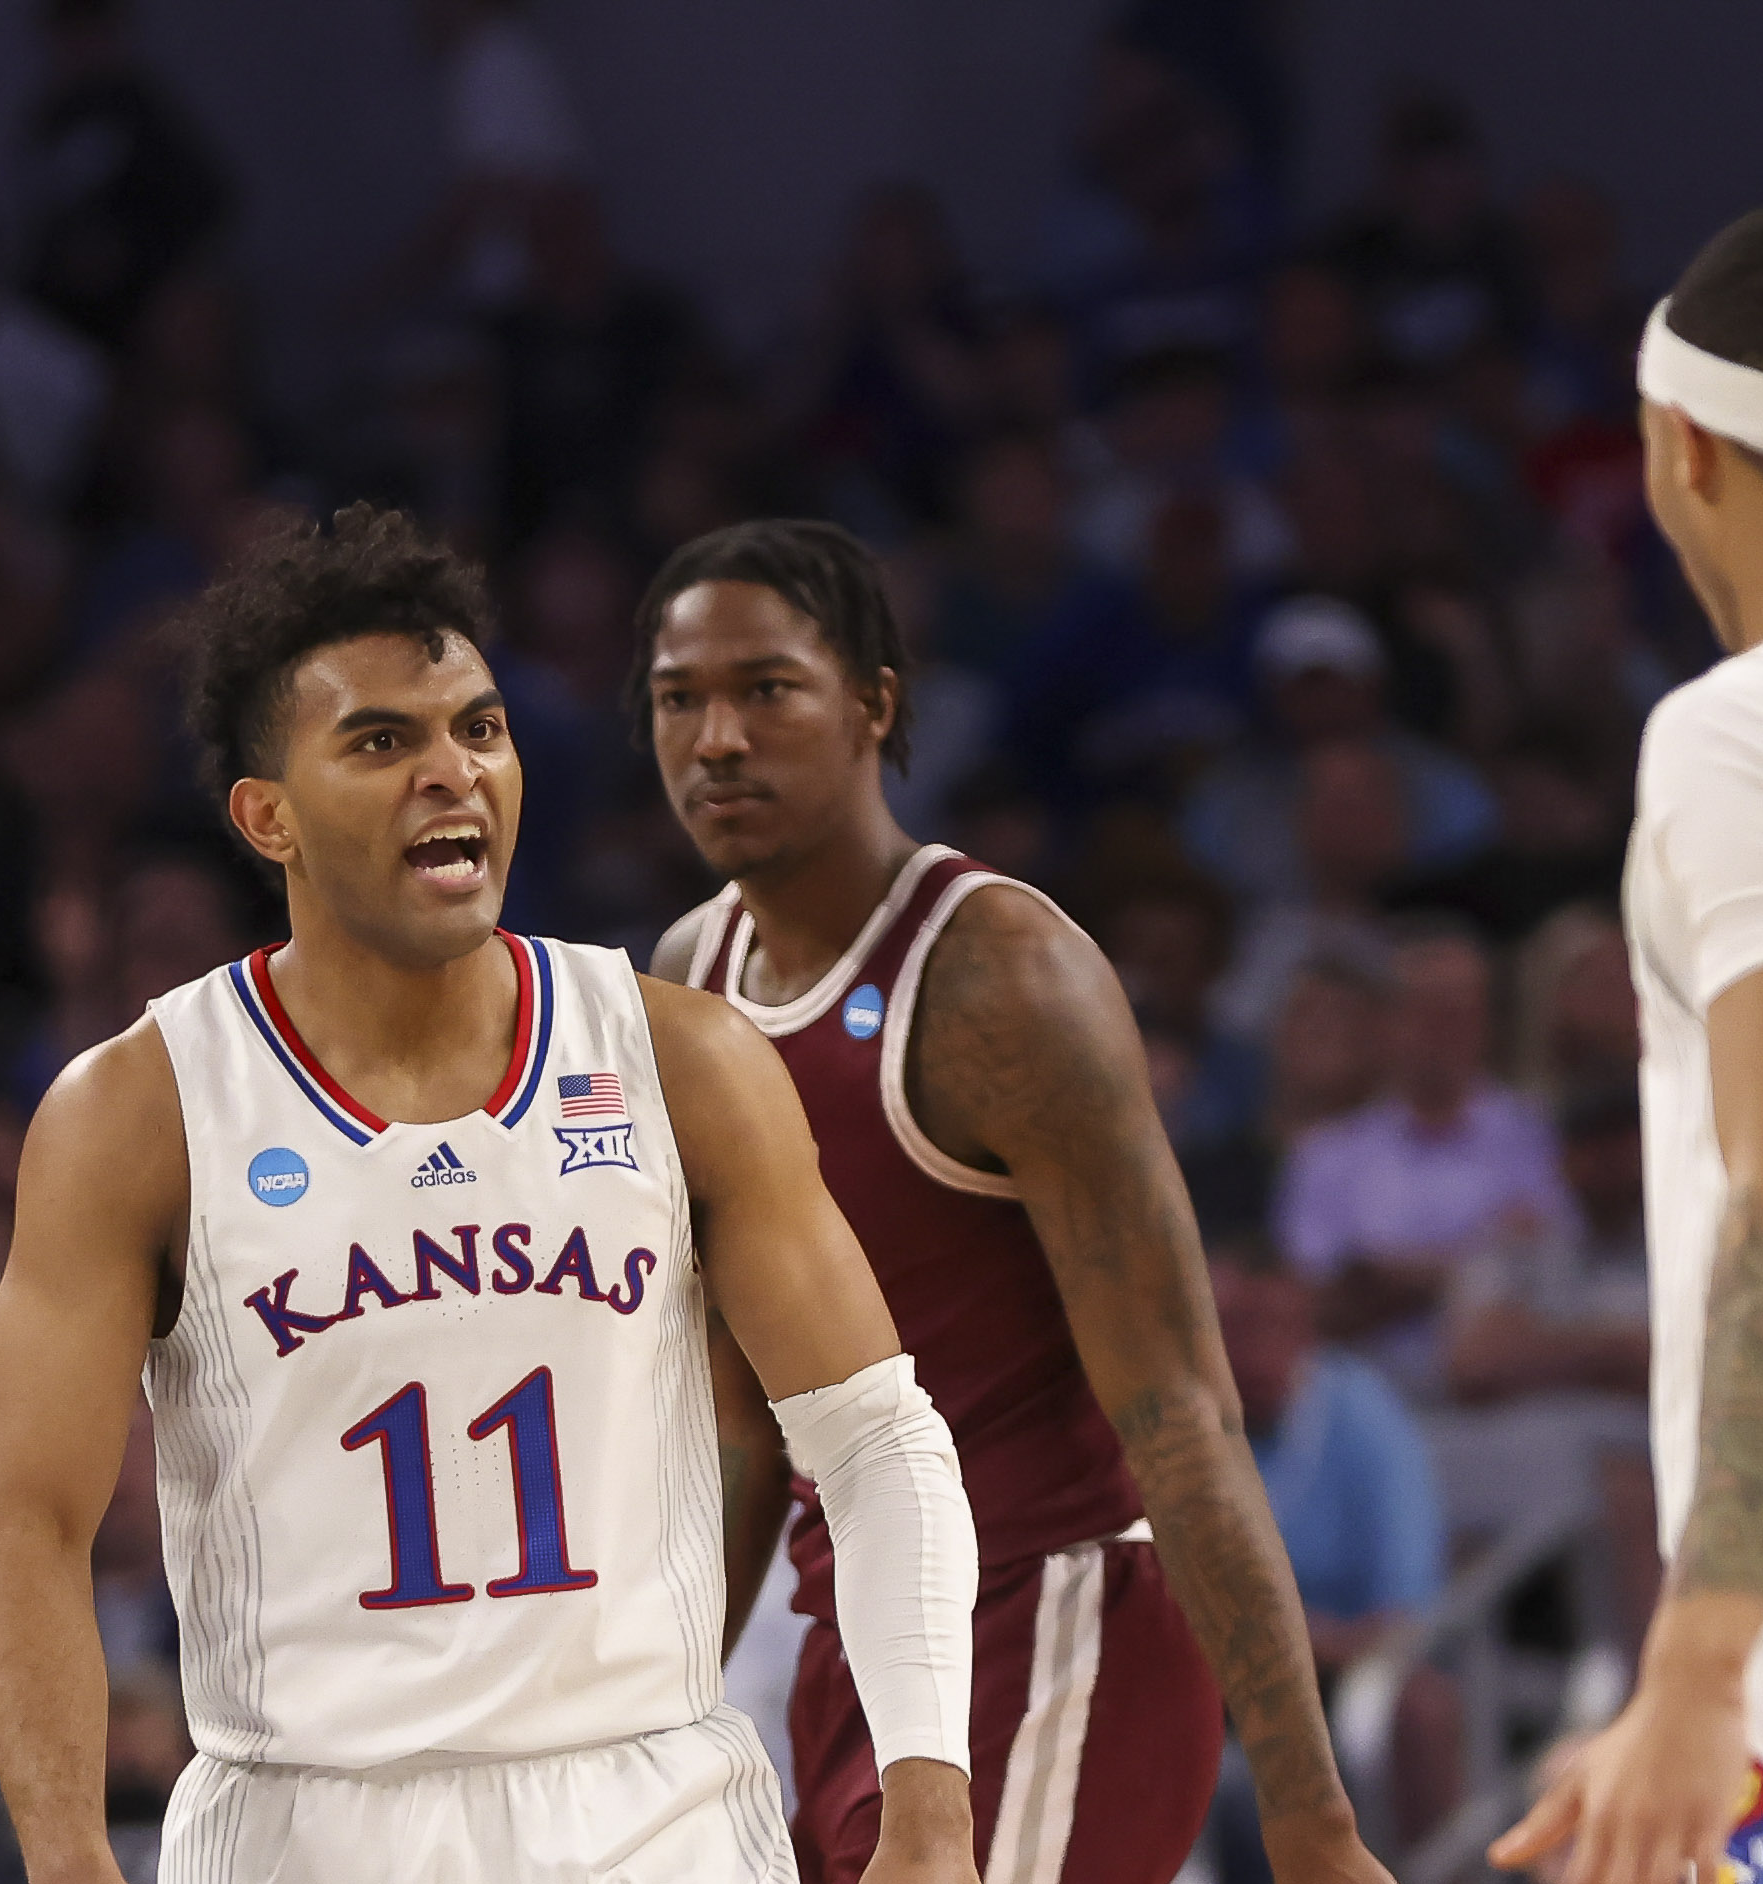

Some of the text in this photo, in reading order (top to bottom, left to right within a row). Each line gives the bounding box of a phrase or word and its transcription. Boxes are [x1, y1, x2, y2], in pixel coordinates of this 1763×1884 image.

[256, 1172, 306, 1193] NCAA
[410, 1167, 478, 1190] adidas
[244, 1223, 657, 1359] KANSAS
[340, 1364, 599, 1611] 11
